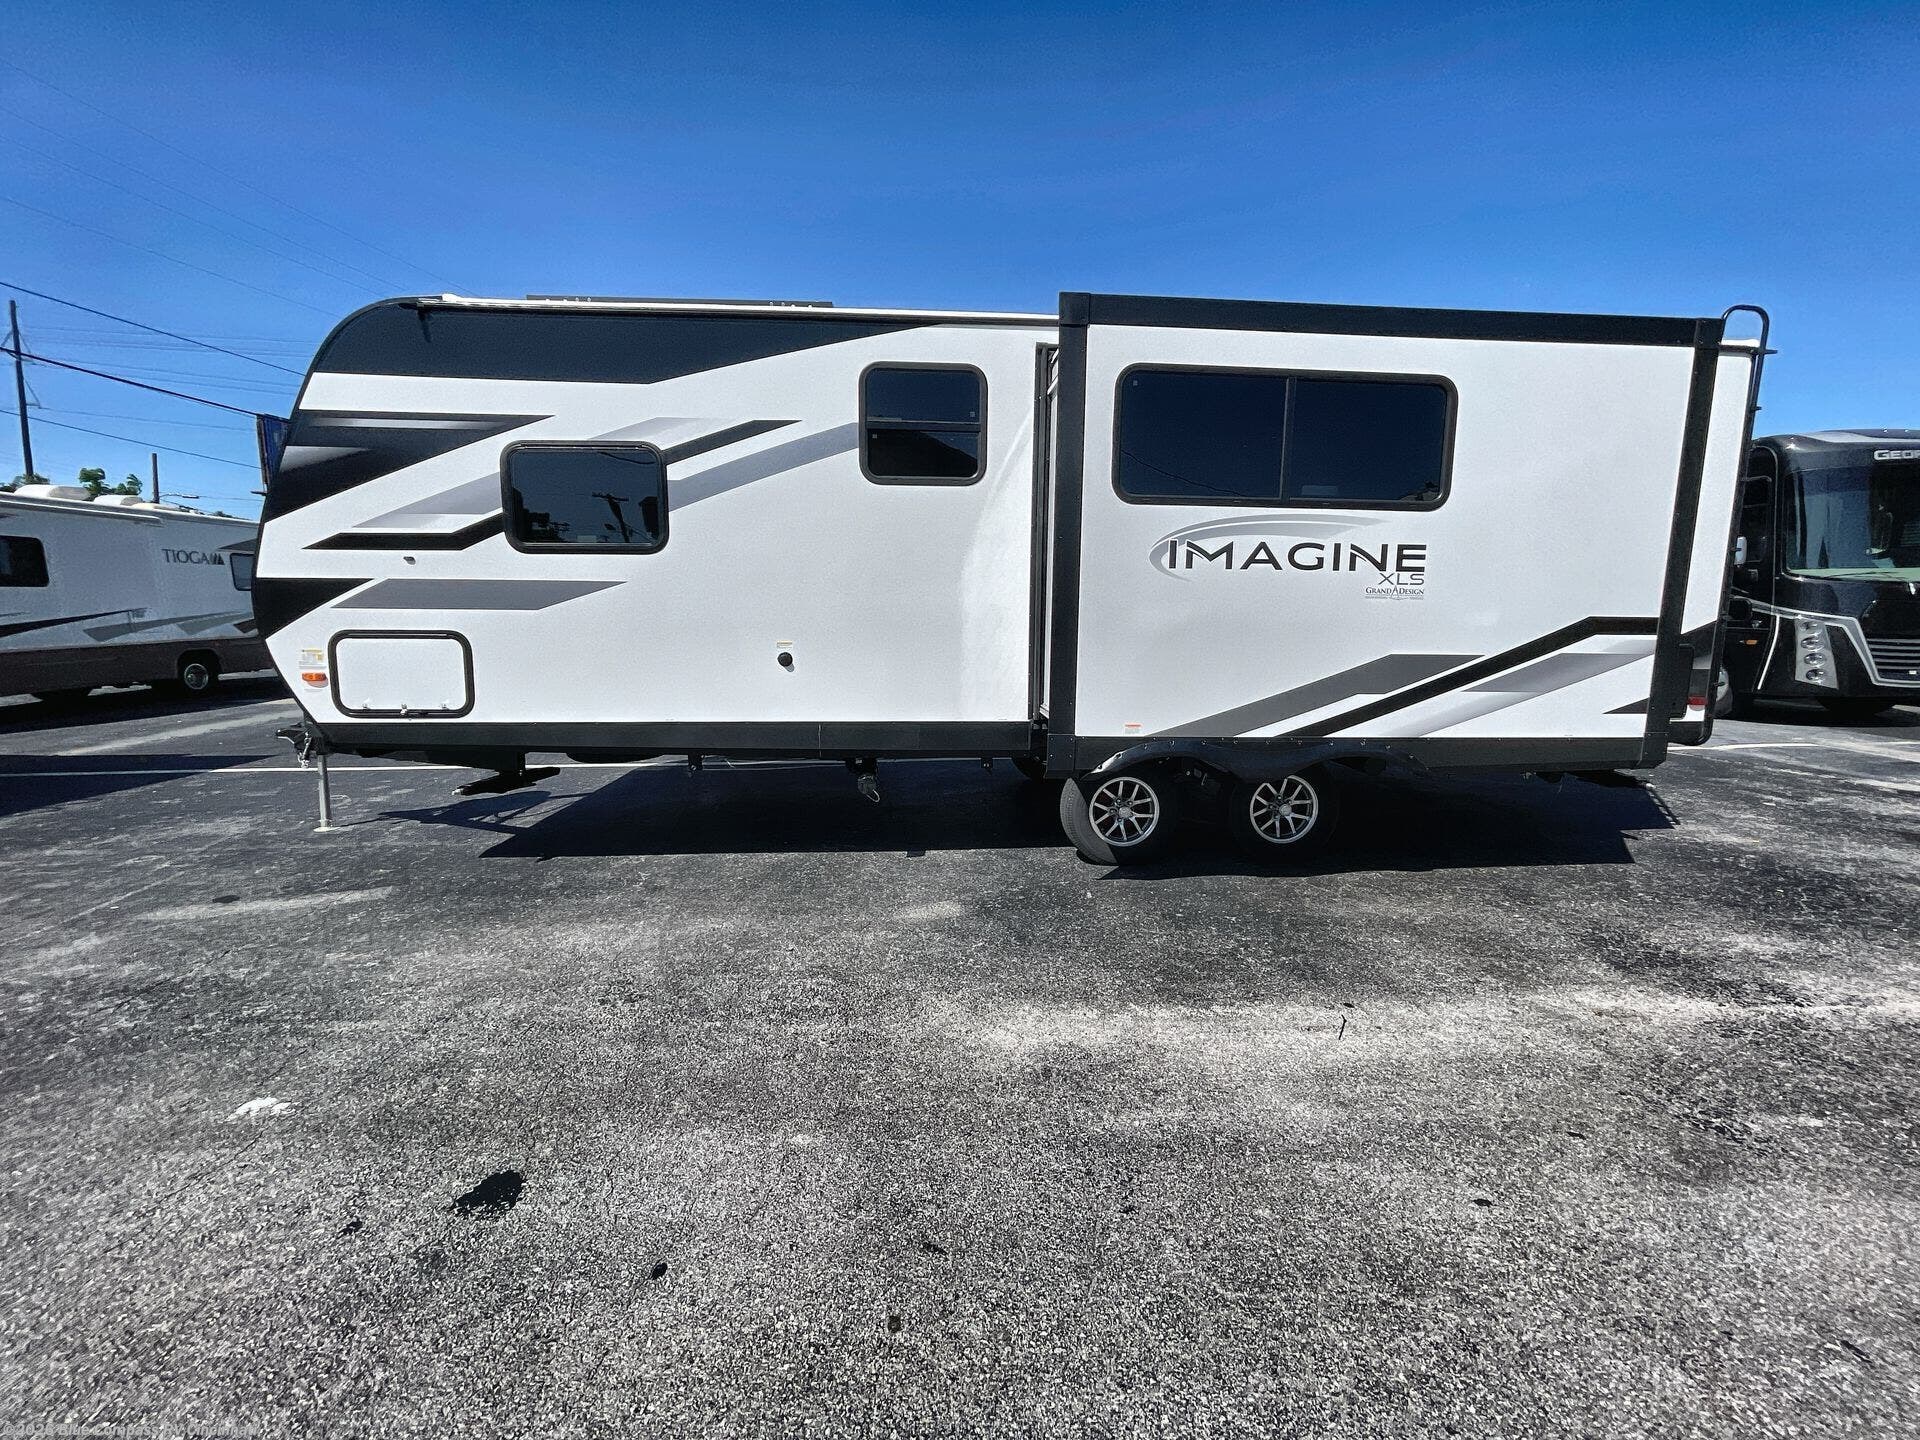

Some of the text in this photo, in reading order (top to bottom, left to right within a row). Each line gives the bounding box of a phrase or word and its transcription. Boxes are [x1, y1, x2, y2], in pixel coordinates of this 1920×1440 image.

[161, 548, 210, 565] TIOGA
[1168, 539, 1427, 573] IMAGINE
[1378, 572, 1425, 586] XLS
